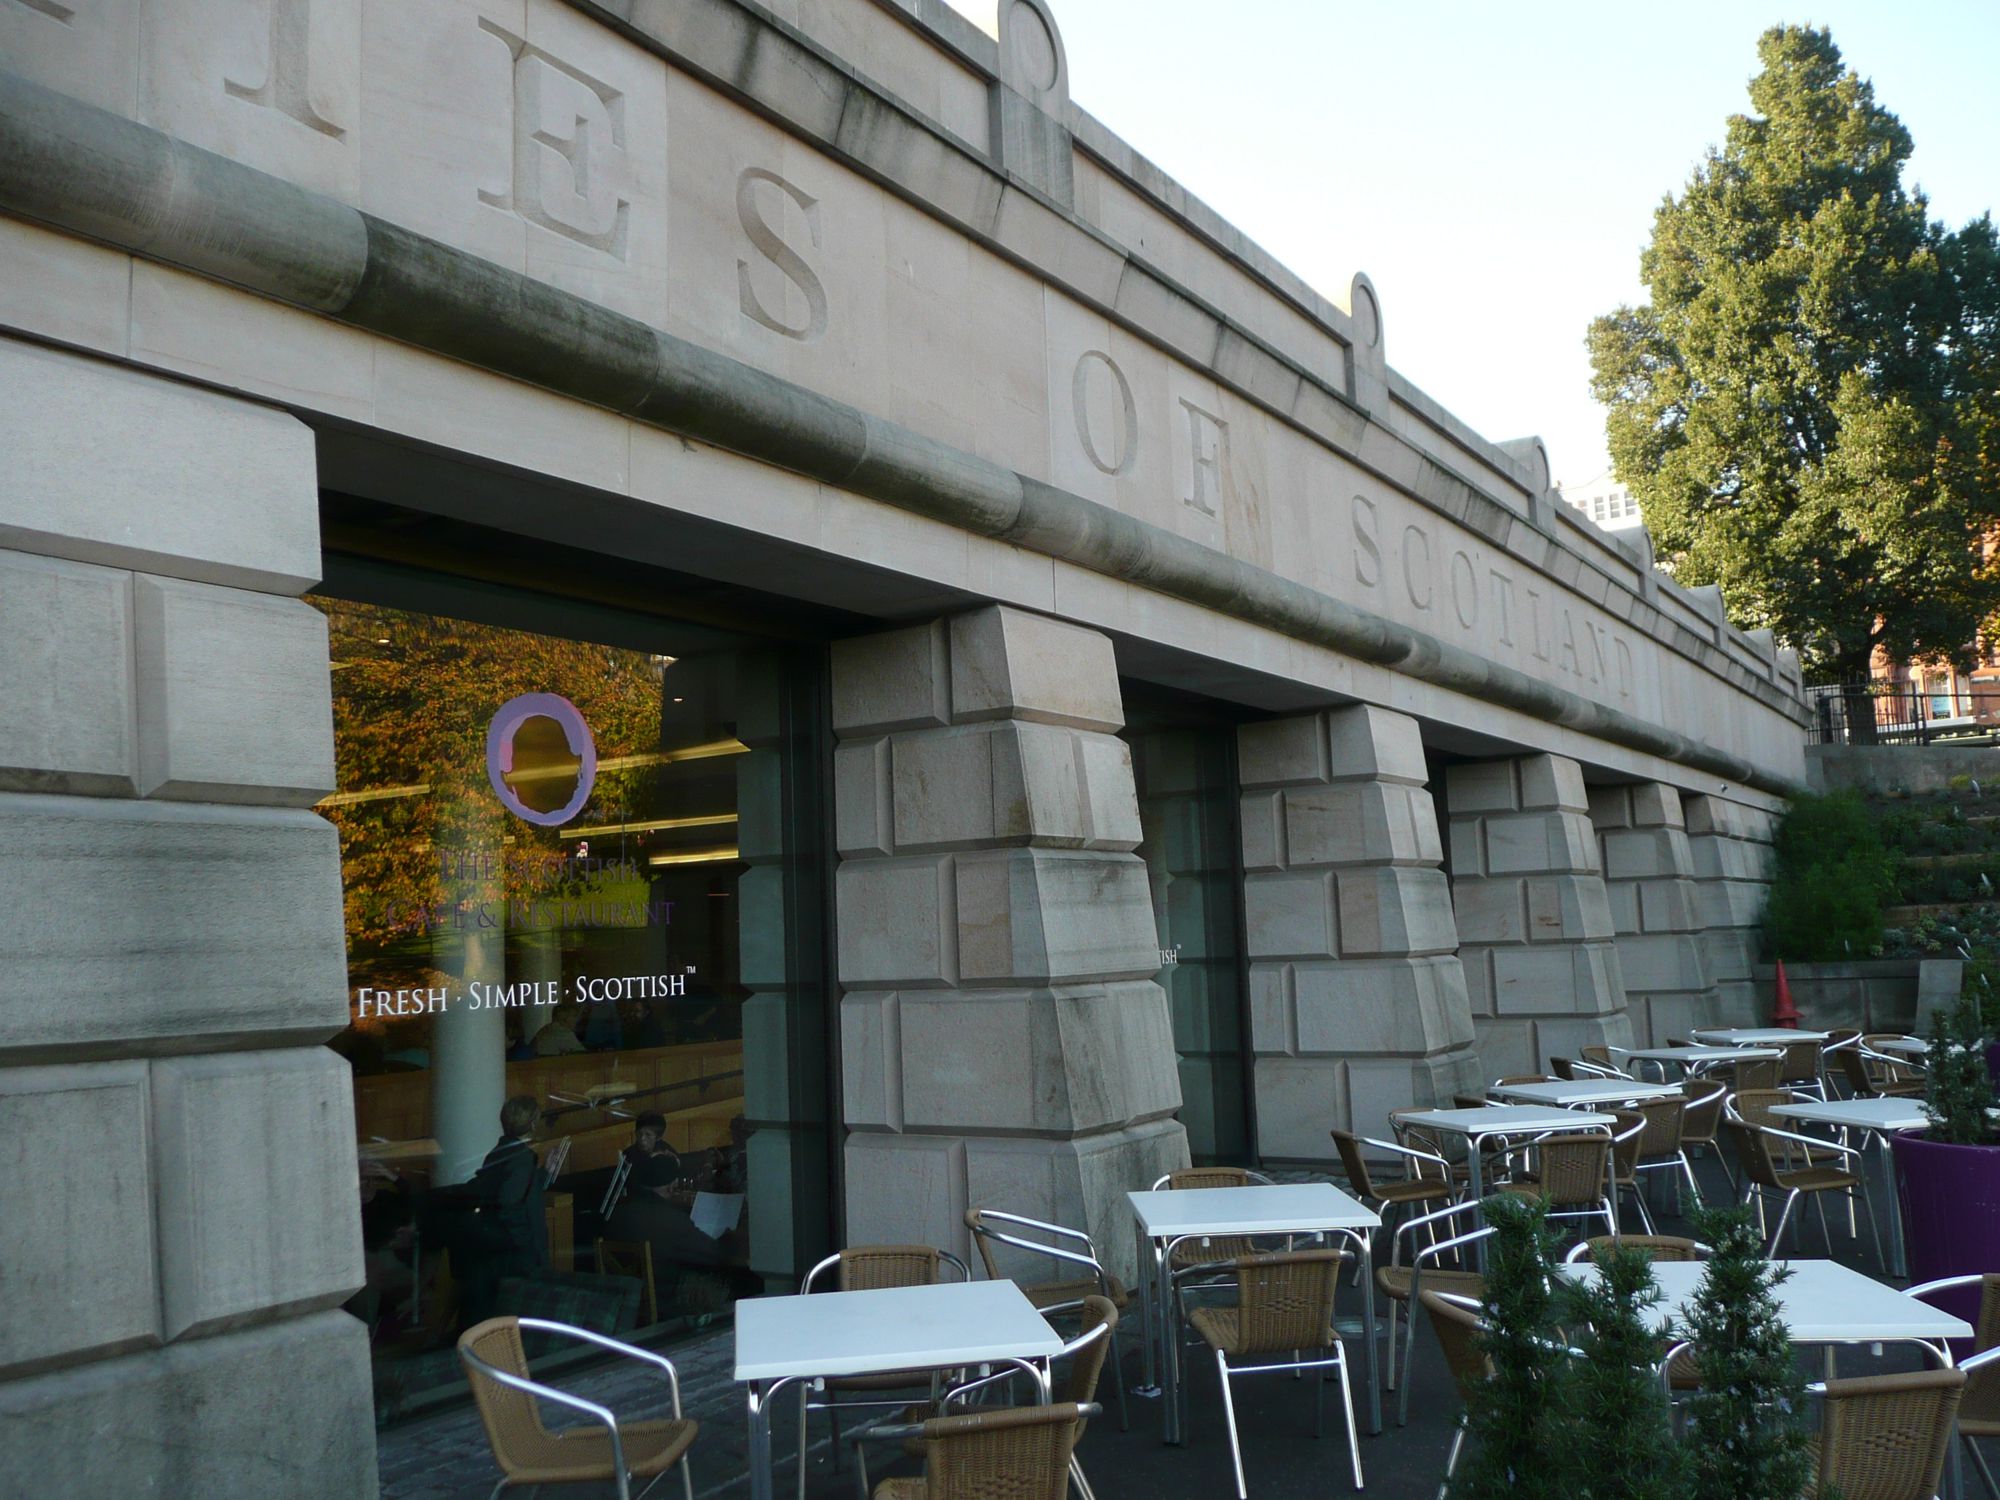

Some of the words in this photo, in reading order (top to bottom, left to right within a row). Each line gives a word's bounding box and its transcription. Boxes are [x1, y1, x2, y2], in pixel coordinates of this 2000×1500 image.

[17, 0, 830, 342] IES
[1072, 350, 1231, 518] OF
[1351, 494, 1633, 698] SCOTLAND
[436, 848, 496, 882] THE
[507, 855, 639, 884] SCOTTISH
[477, 902, 499, 928] &
[510, 900, 676, 929] RESTAURANT
[358, 987, 448, 1018] FRESH
[469, 981, 558, 1010] SIMPLE
[576, 974, 686, 1003] SCOTTISH
